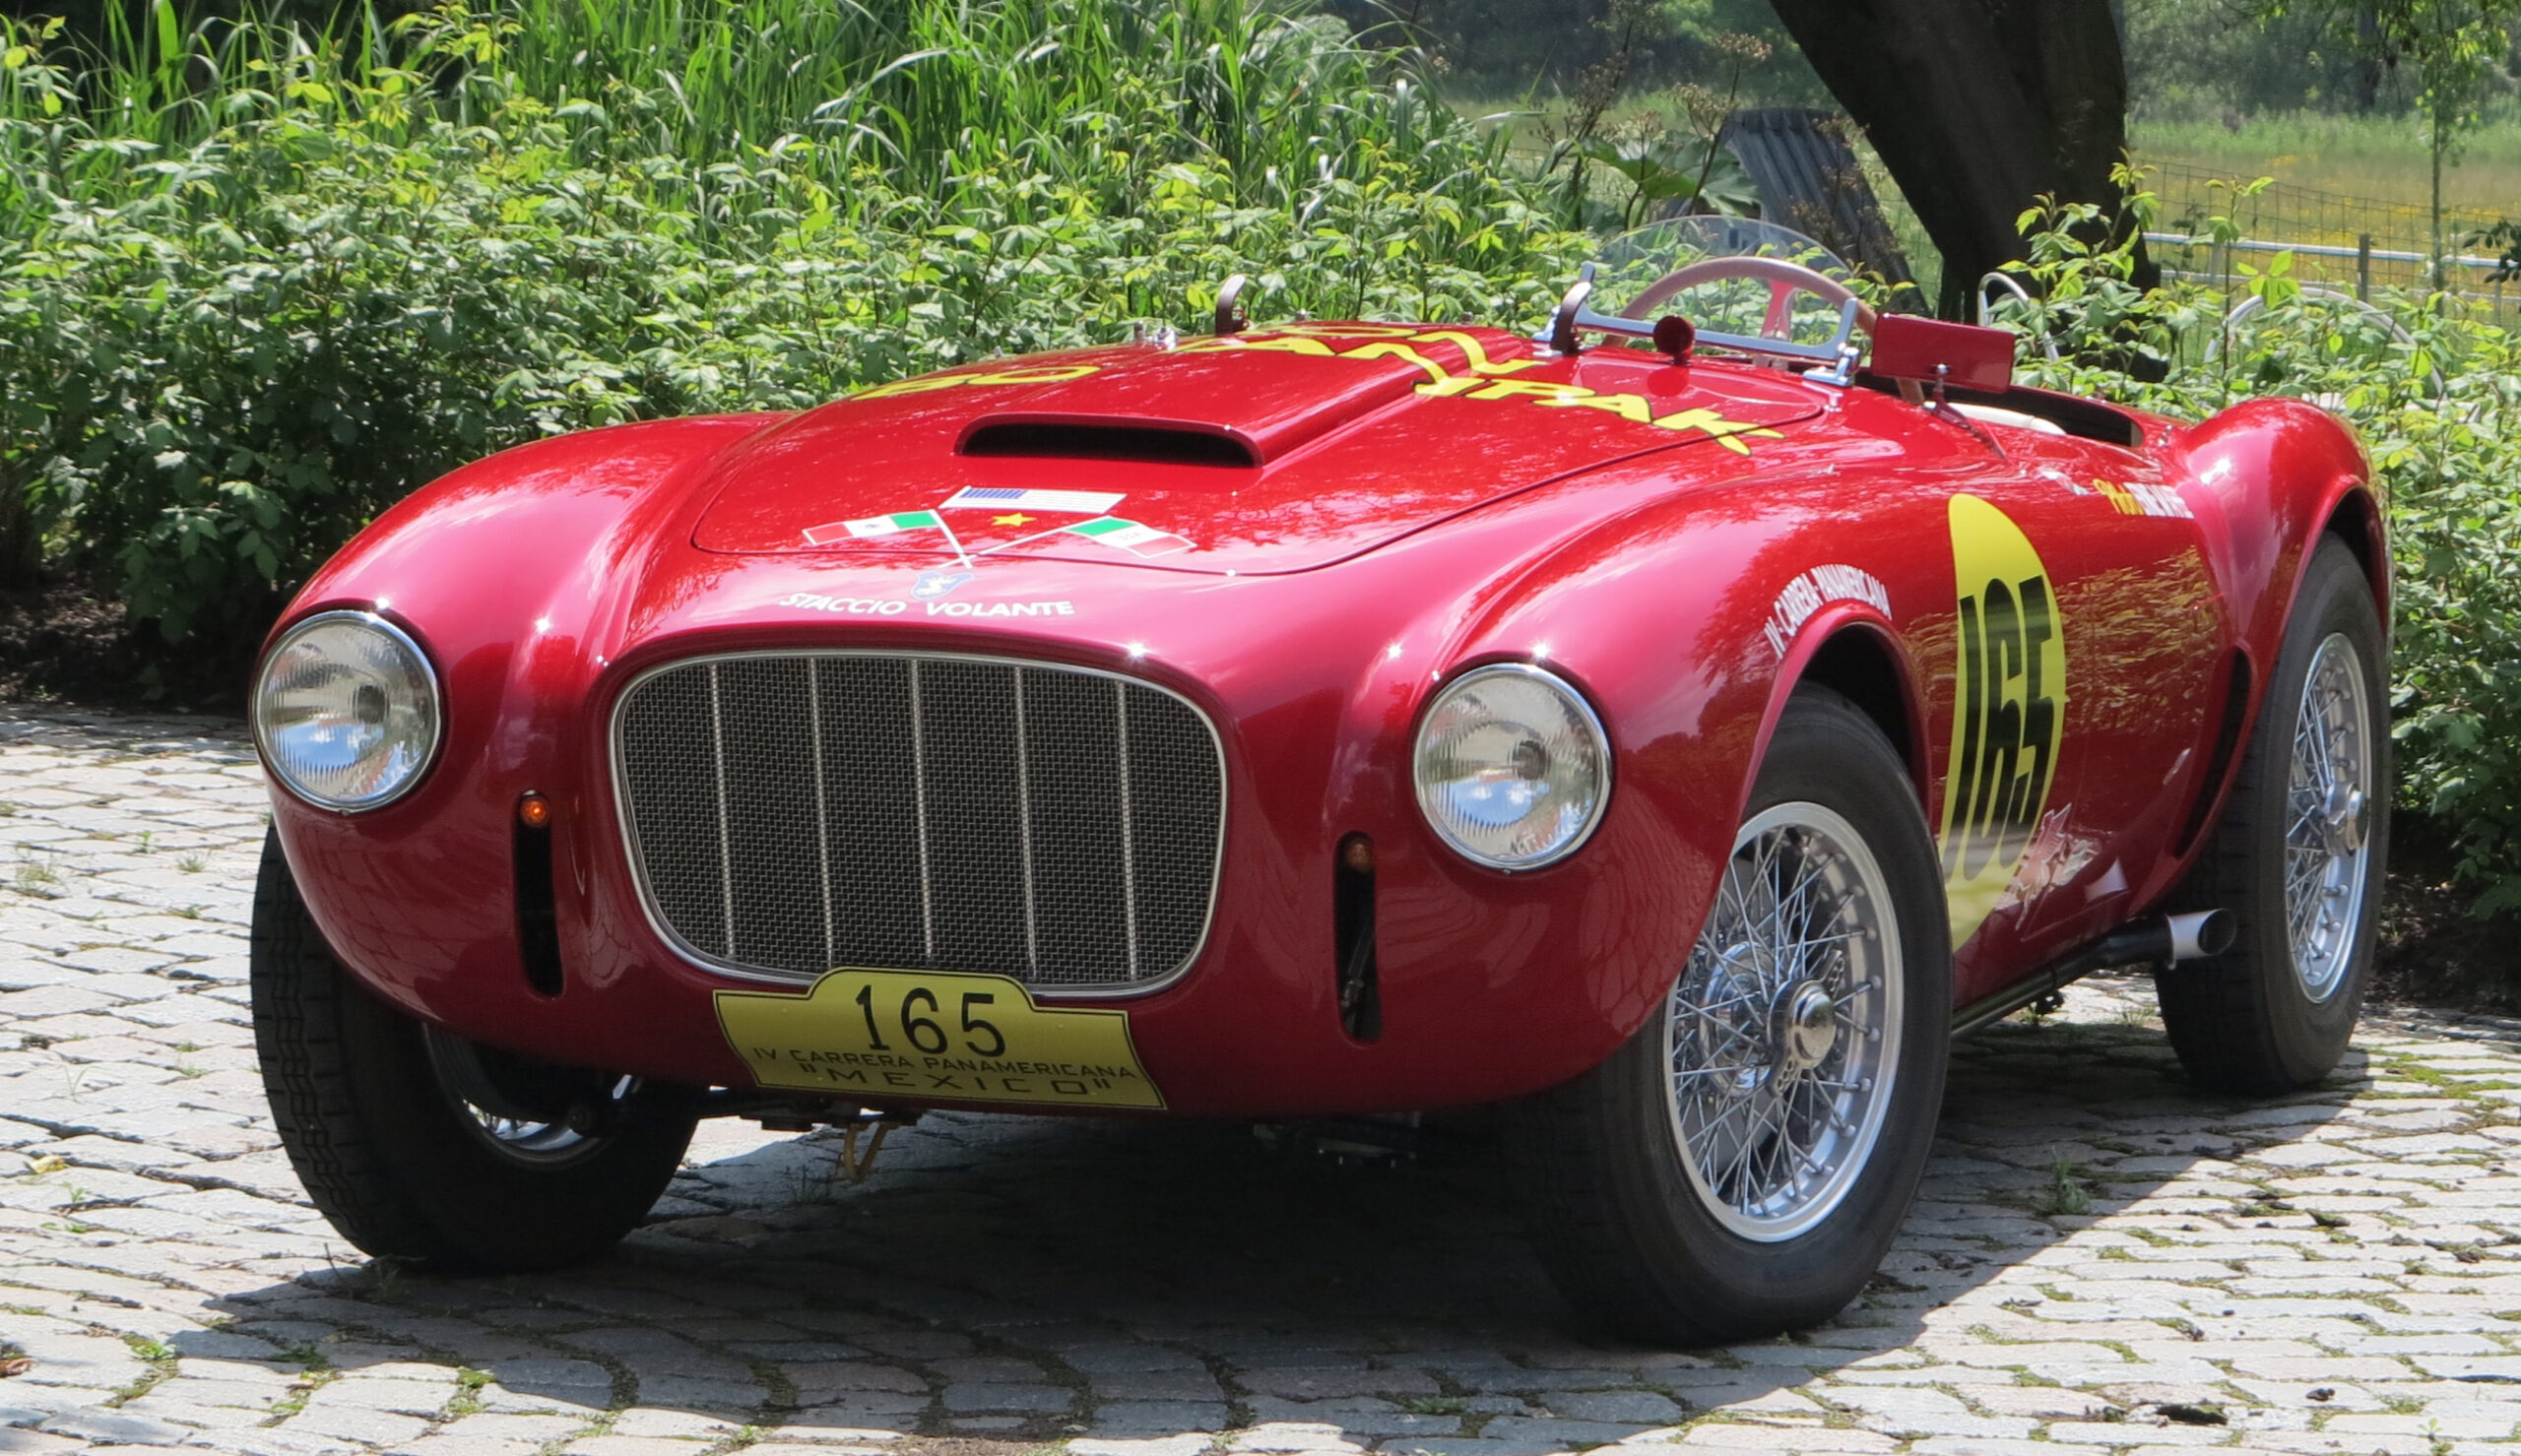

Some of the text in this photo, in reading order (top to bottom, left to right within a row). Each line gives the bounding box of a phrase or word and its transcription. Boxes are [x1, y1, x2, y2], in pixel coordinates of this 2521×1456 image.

[780, 594, 1075, 617] STACCIO VOLANTE
[1943, 575, 2053, 882] 165
[855, 983, 1006, 1057] 165
[753, 1047, 1135, 1078] IV CARRERA PANAMERICANA
